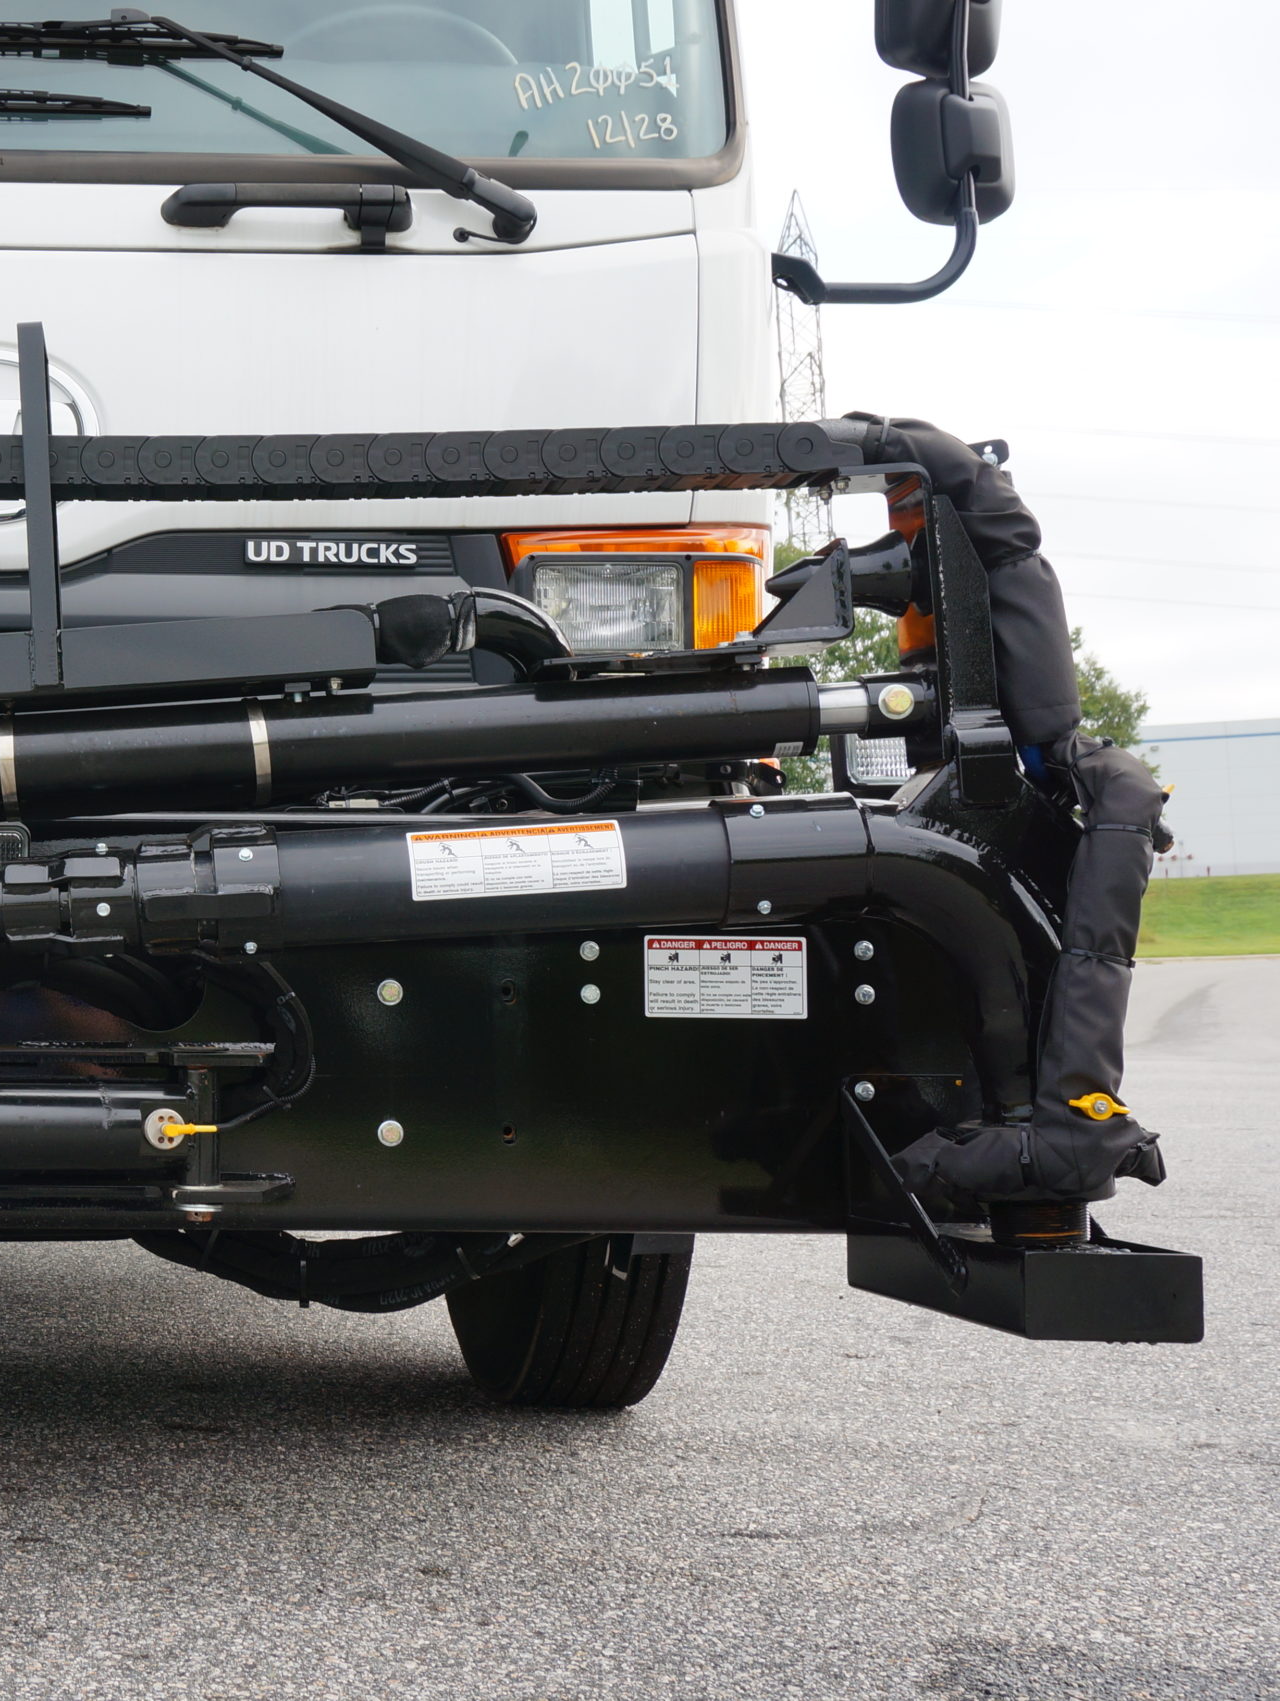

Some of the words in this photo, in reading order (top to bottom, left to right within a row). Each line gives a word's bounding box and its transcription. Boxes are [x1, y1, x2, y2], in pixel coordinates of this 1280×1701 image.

[587, 111, 678, 149] 12/28
[247, 541, 290, 562] UD
[297, 541, 418, 565] TRUCKS
[489, 828, 545, 837] ADVERTENCIA
[557, 824, 615, 833] AVERTISSEMENT
[424, 832, 478, 841] WARNING
[660, 941, 696, 949] DANGER
[711, 941, 748, 949] PELIGRO
[763, 942, 798, 950] DANGER
